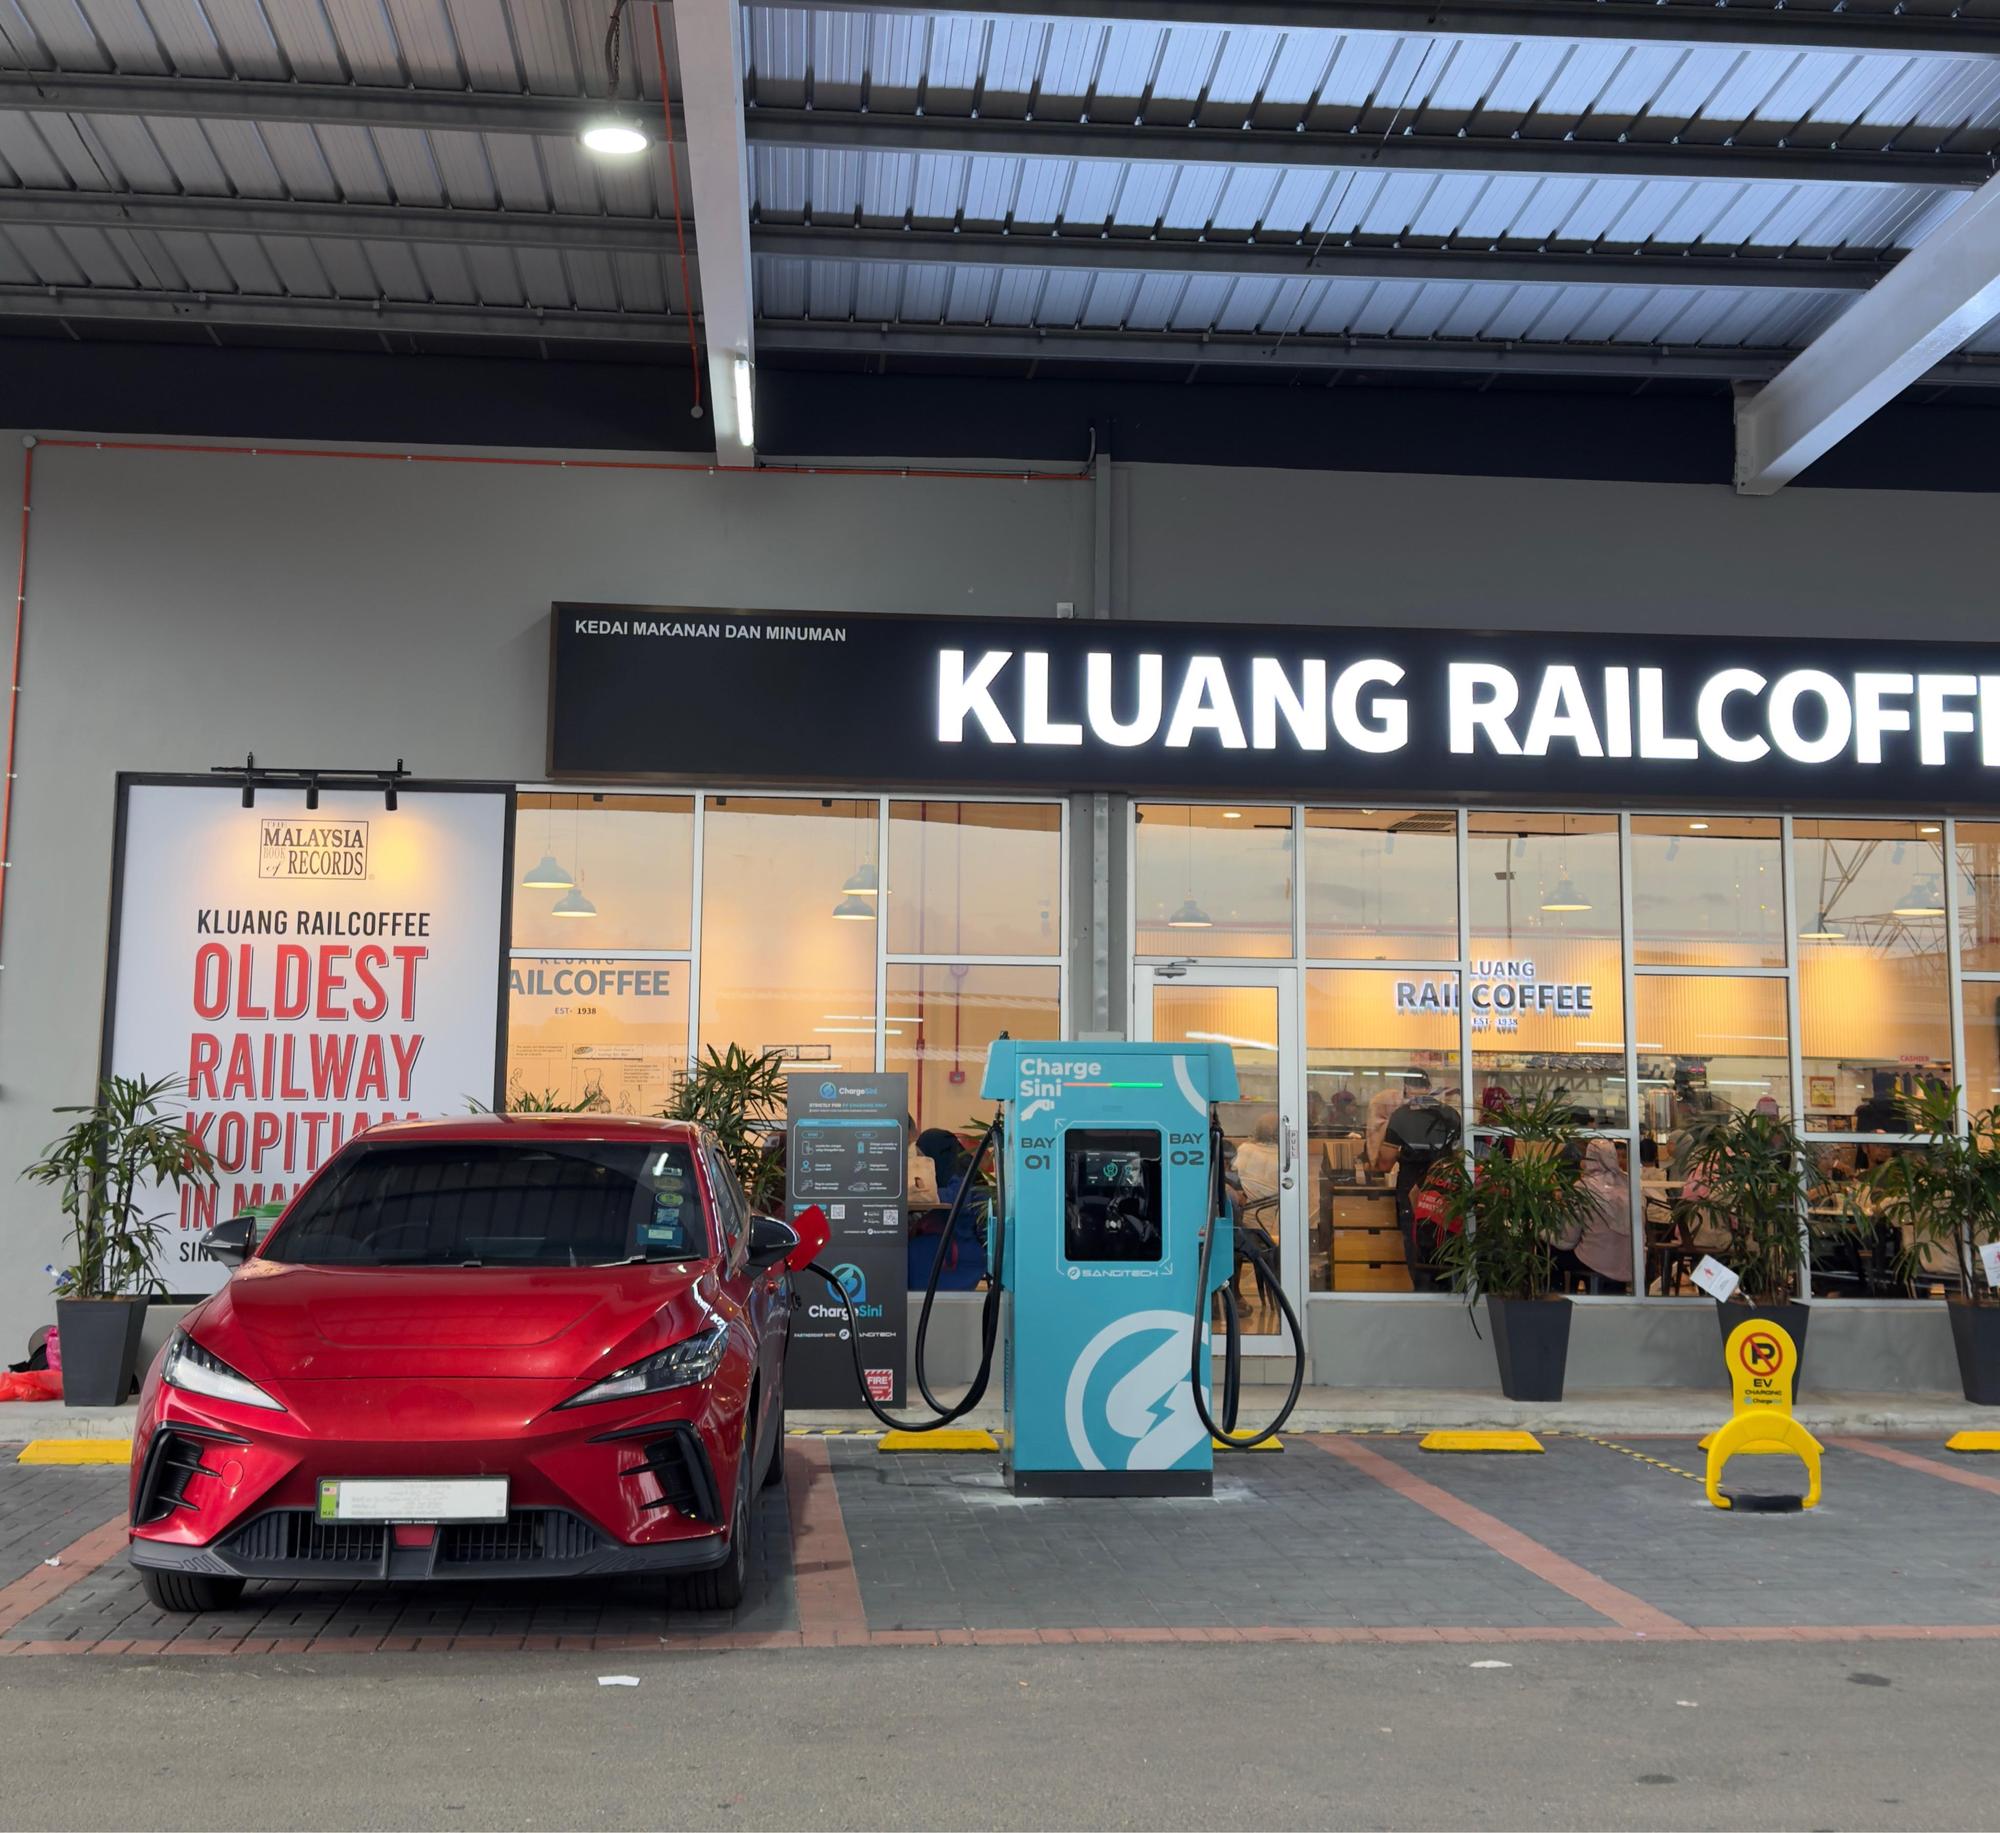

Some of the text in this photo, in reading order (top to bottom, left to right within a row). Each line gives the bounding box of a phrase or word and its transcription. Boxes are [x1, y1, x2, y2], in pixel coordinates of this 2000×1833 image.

[575, 620, 846, 642] KEDAI MAKANAN DAN MINUMAN
[937, 649, 1408, 754] KLUANG
[263, 828, 364, 848] MALAYSIA
[288, 850, 364, 876] RECORDS
[197, 909, 431, 937] KLUANG RAILCOFFEE
[1469, 961, 1535, 977] LUANG
[193, 942, 428, 1023] OLDEST
[510, 969, 670, 996] AILCOFFEE
[1497, 1018, 1518, 1026] 1938
[187, 1033, 425, 1101] RAILWAY
[1020, 1058, 1102, 1080] Charge
[1020, 1078, 1062, 1097] Sini
[183, 1111, 421, 1173] KOPITI
[1021, 1137, 1056, 1149] BAY
[1169, 1133, 1204, 1145] BAY
[180, 1183, 220, 1231] IN
[808, 1304, 882, 1320] ChargeSini
[867, 1376, 888, 1385] FIRE
[1753, 1378, 1773, 1388] EV
